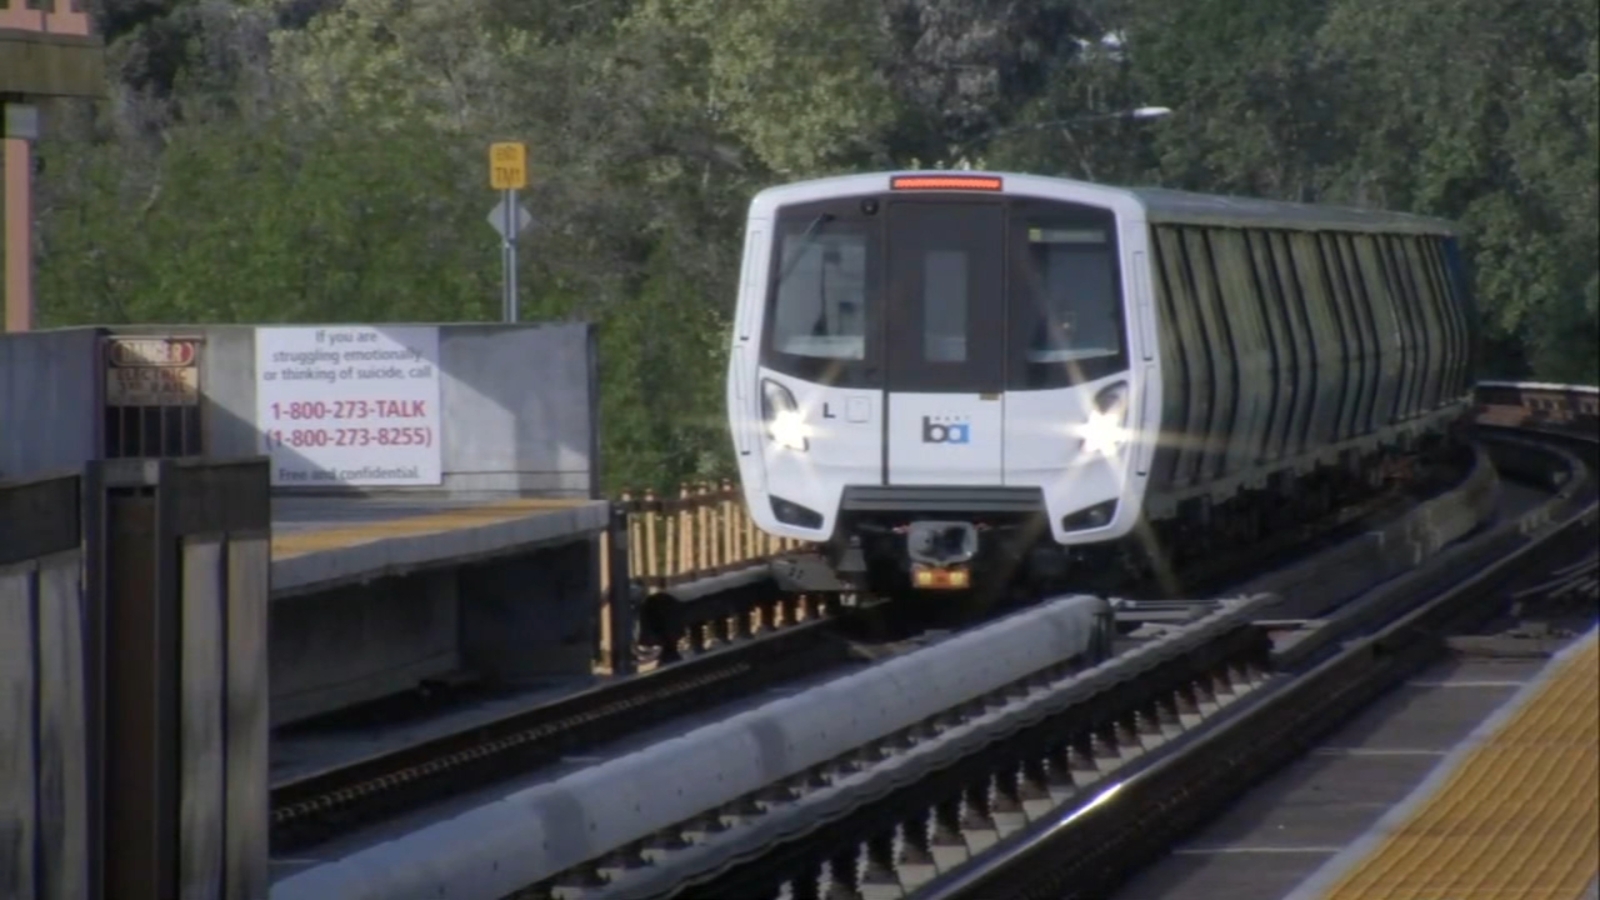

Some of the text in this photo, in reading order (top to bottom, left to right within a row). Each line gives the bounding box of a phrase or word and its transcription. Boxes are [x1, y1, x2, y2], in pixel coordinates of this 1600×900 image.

[315, 330, 377, 345] If you are
[272, 346, 422, 365] struggling emotionally
[263, 371, 279, 381] or
[282, 367, 336, 383] thinking
[339, 366, 353, 380] of
[408, 365, 432, 379] call
[271, 400, 425, 420] 1-800-273-TALK
[823, 402, 836, 418] L
[266, 427, 432, 450] (1-800-273-8255)
[279, 468, 307, 481] Free
[311, 467, 336, 481] and
